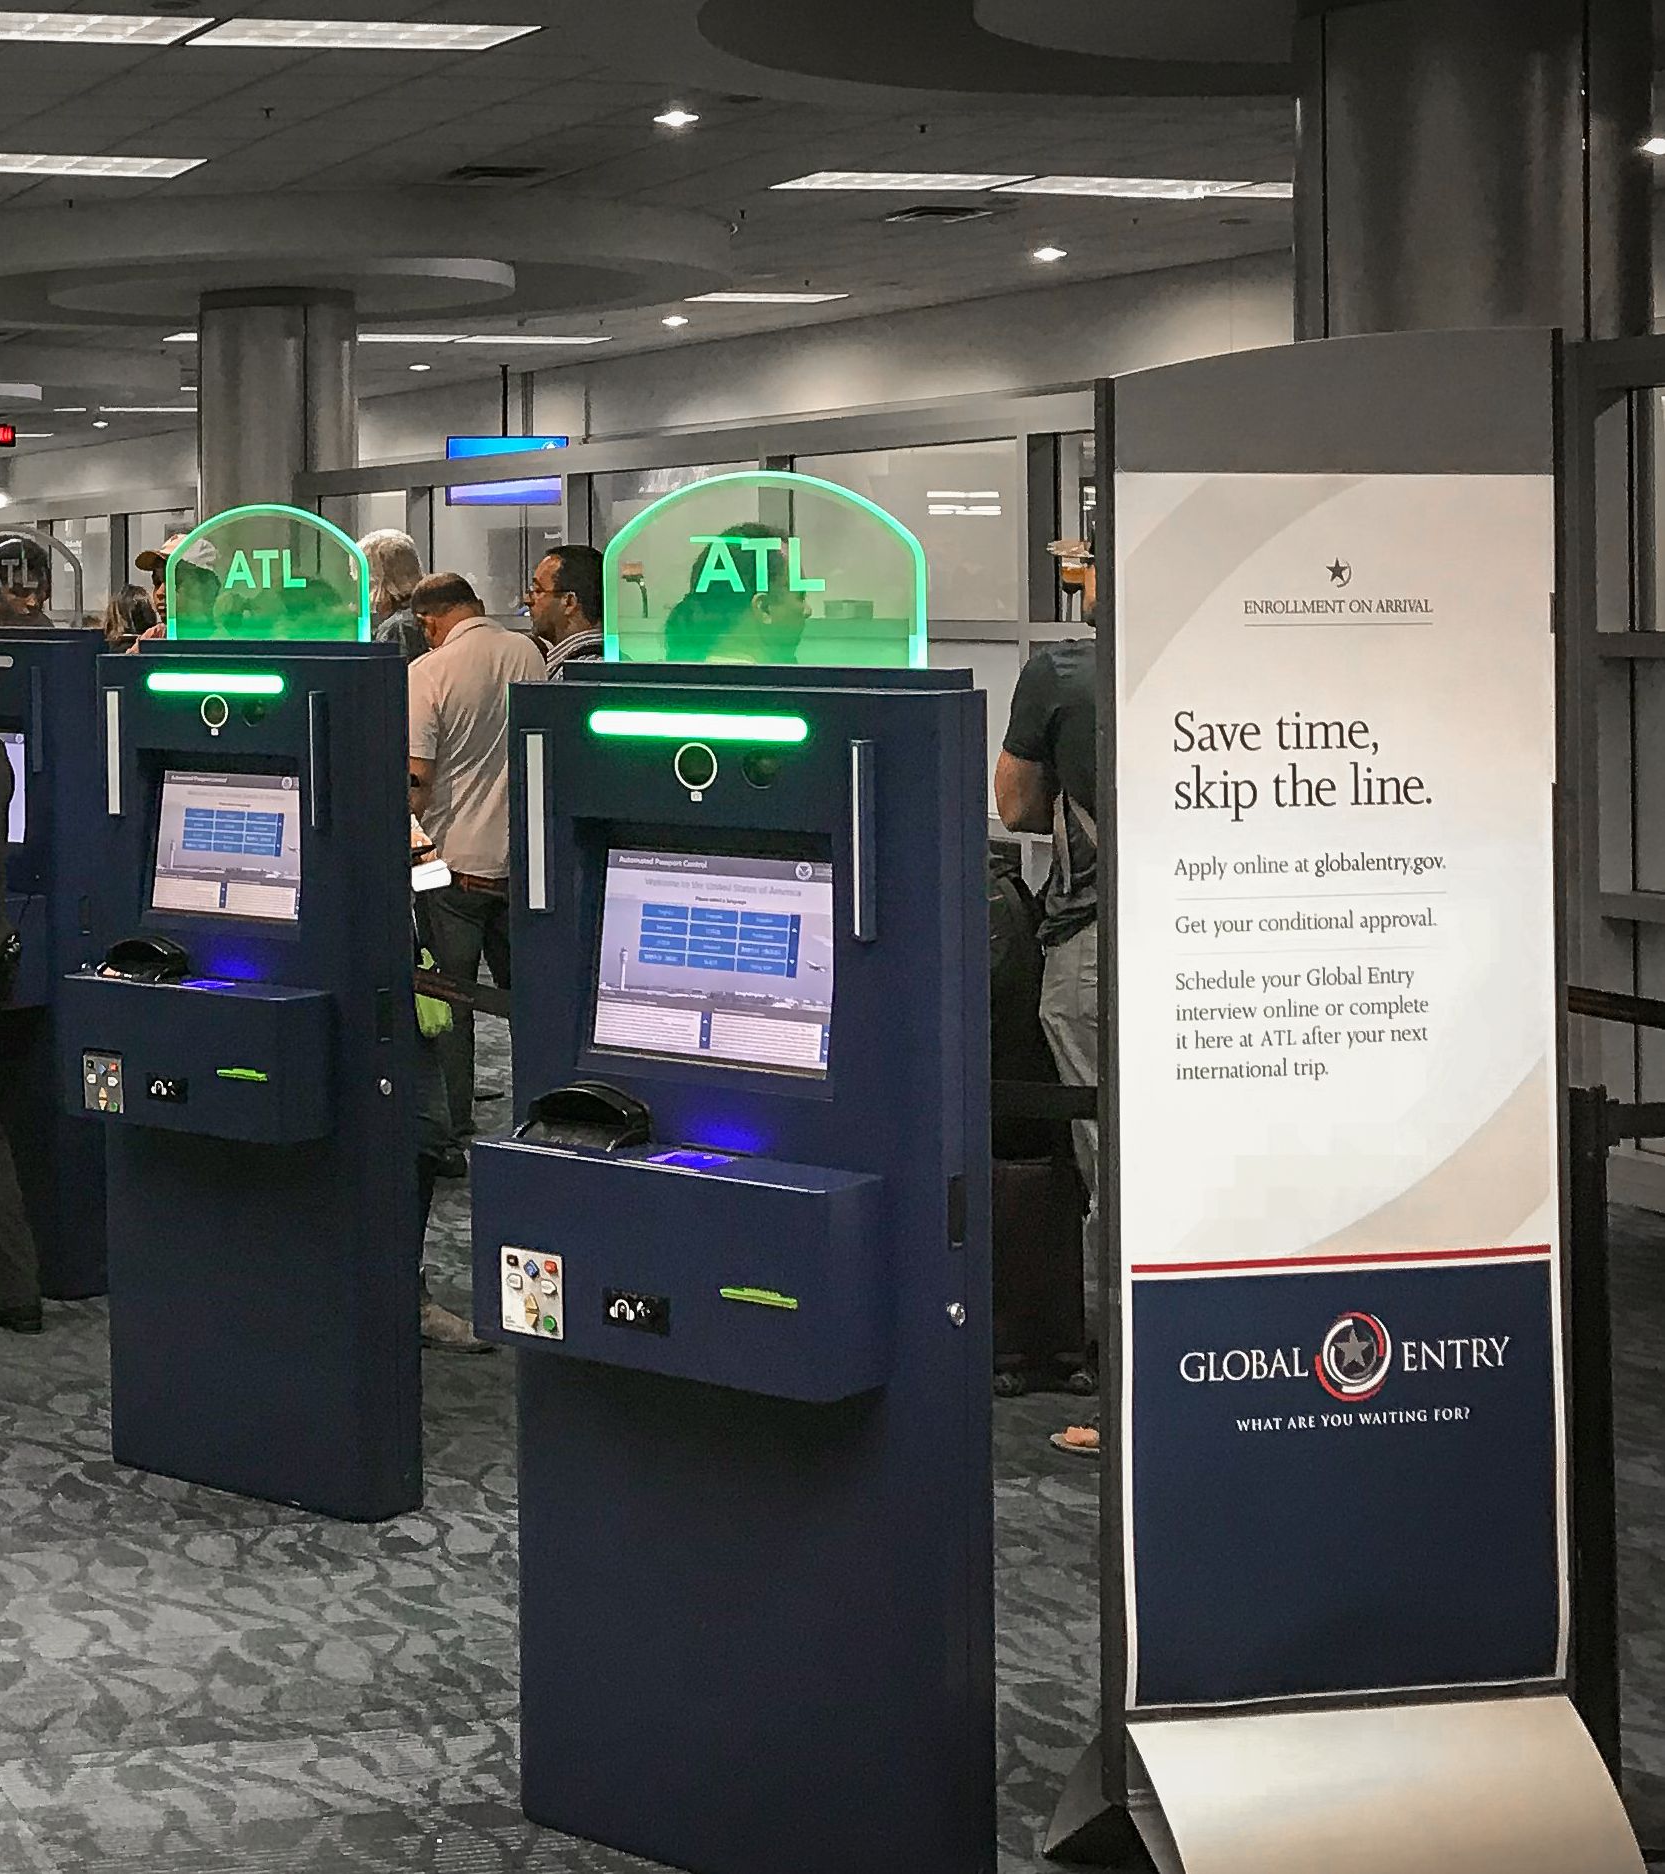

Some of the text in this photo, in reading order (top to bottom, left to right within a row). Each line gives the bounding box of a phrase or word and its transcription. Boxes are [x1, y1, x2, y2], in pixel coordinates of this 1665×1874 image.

[224, 549, 307, 589] ATL
[695, 537, 826, 593] ATL
[1244, 599, 1434, 615] ENROLLMENT ON ARRIVAL
[1173, 711, 1380, 755] Save time,
[1174, 762, 1433, 824] skip the line.
[618, 856, 708, 869] Automated Passport Control
[1174, 852, 1446, 881] Apply online at globalentry.gov.
[1175, 907, 1438, 938] Get your conditional approval.
[1175, 966, 1414, 993] Schedule your Global Entry
[1176, 995, 1430, 1022] interview online or complete
[1176, 1026, 1428, 1049] it here at ATL after your next
[1176, 1057, 1329, 1081] international trip.
[1179, 1336, 1510, 1383] GLOBAL ENTRY
[1236, 1406, 1471, 1432] WHAT ARE YOU WAITING FOR?
